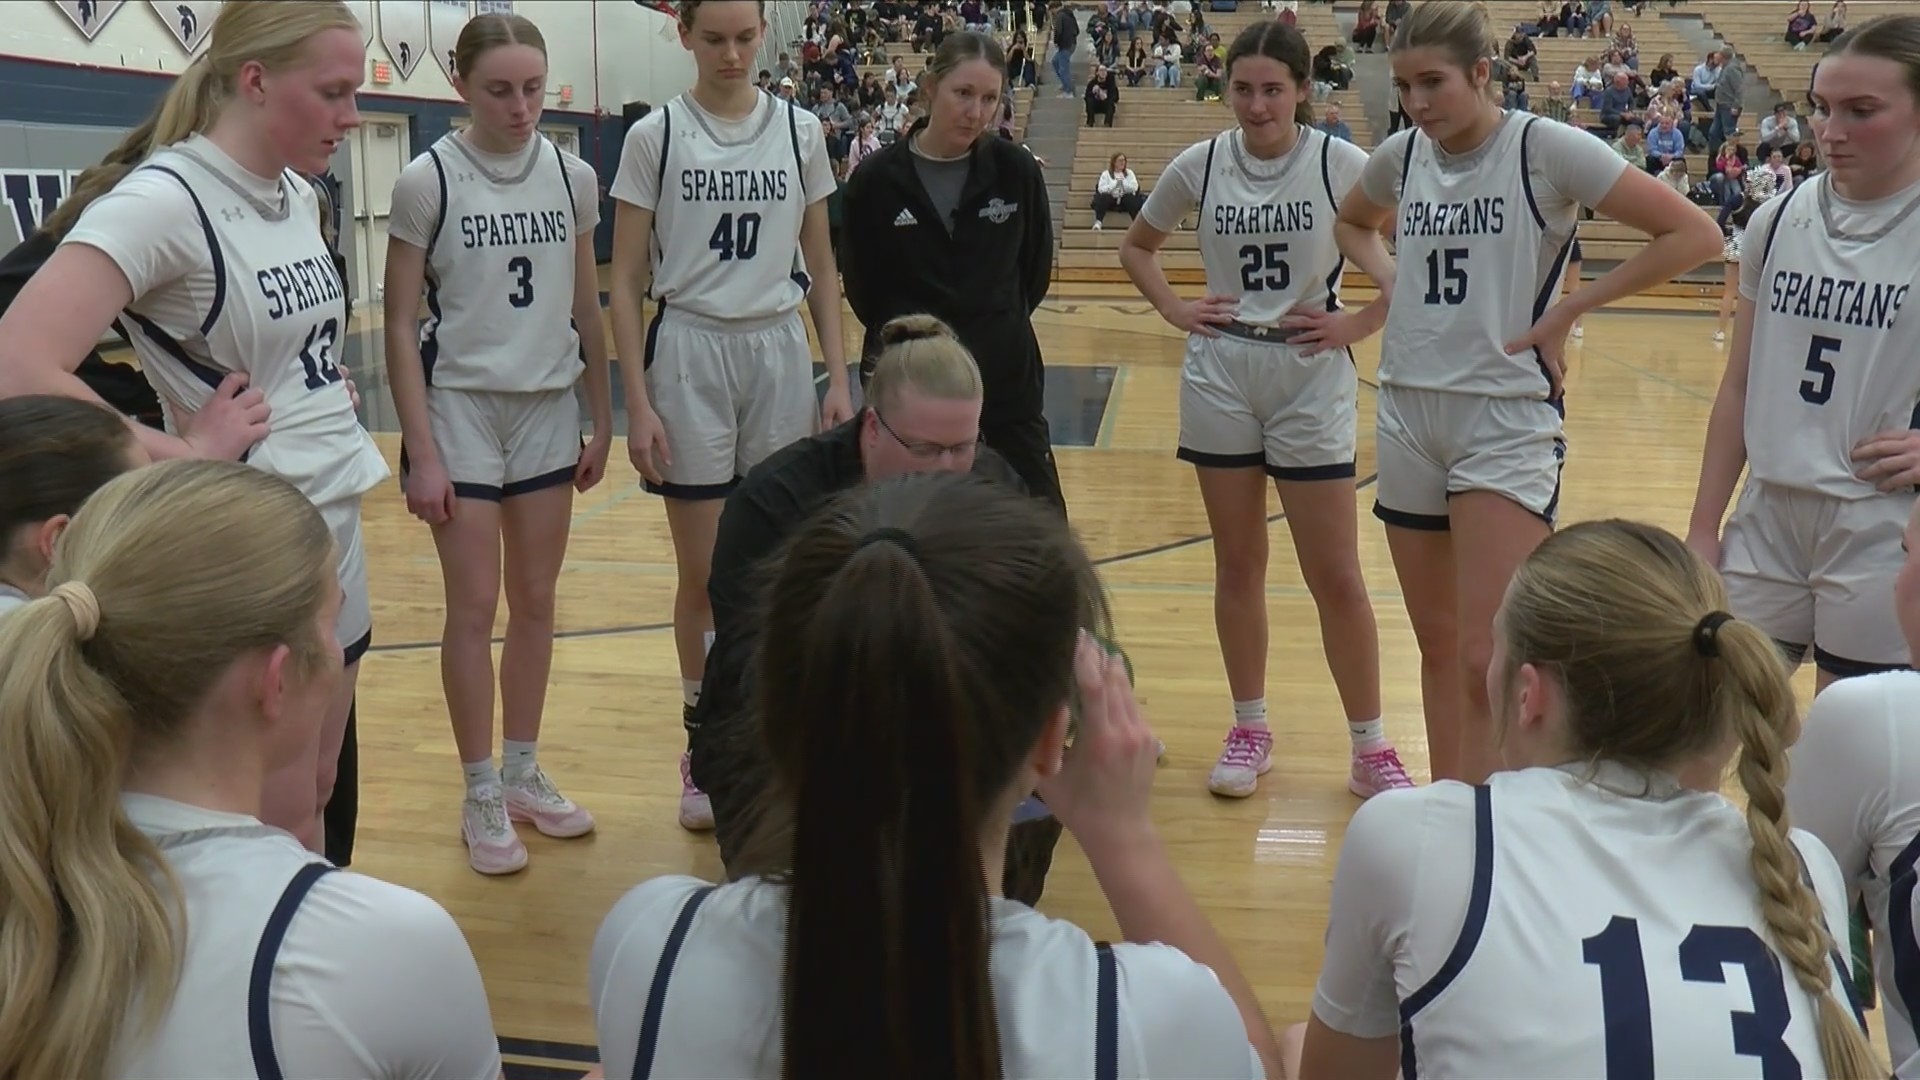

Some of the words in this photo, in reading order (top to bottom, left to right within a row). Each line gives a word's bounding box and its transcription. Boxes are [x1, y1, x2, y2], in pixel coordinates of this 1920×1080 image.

[681, 169, 788, 202] SPARTANS
[461, 210, 567, 249] SPARTANS
[709, 212, 762, 262] 40
[1215, 201, 1313, 235] SPARTANS
[1403, 197, 1504, 236] SPARTANS
[256, 253, 343, 320] SPARTAN
[508, 256, 534, 309] 3
[1239, 243, 1290, 291] 25
[1424, 248, 1469, 305] 15
[1771, 270, 1910, 330] SPARTANS
[299, 316, 342, 391] 12
[1799, 334, 1842, 406] 5
[1582, 914, 1803, 1080] 13
